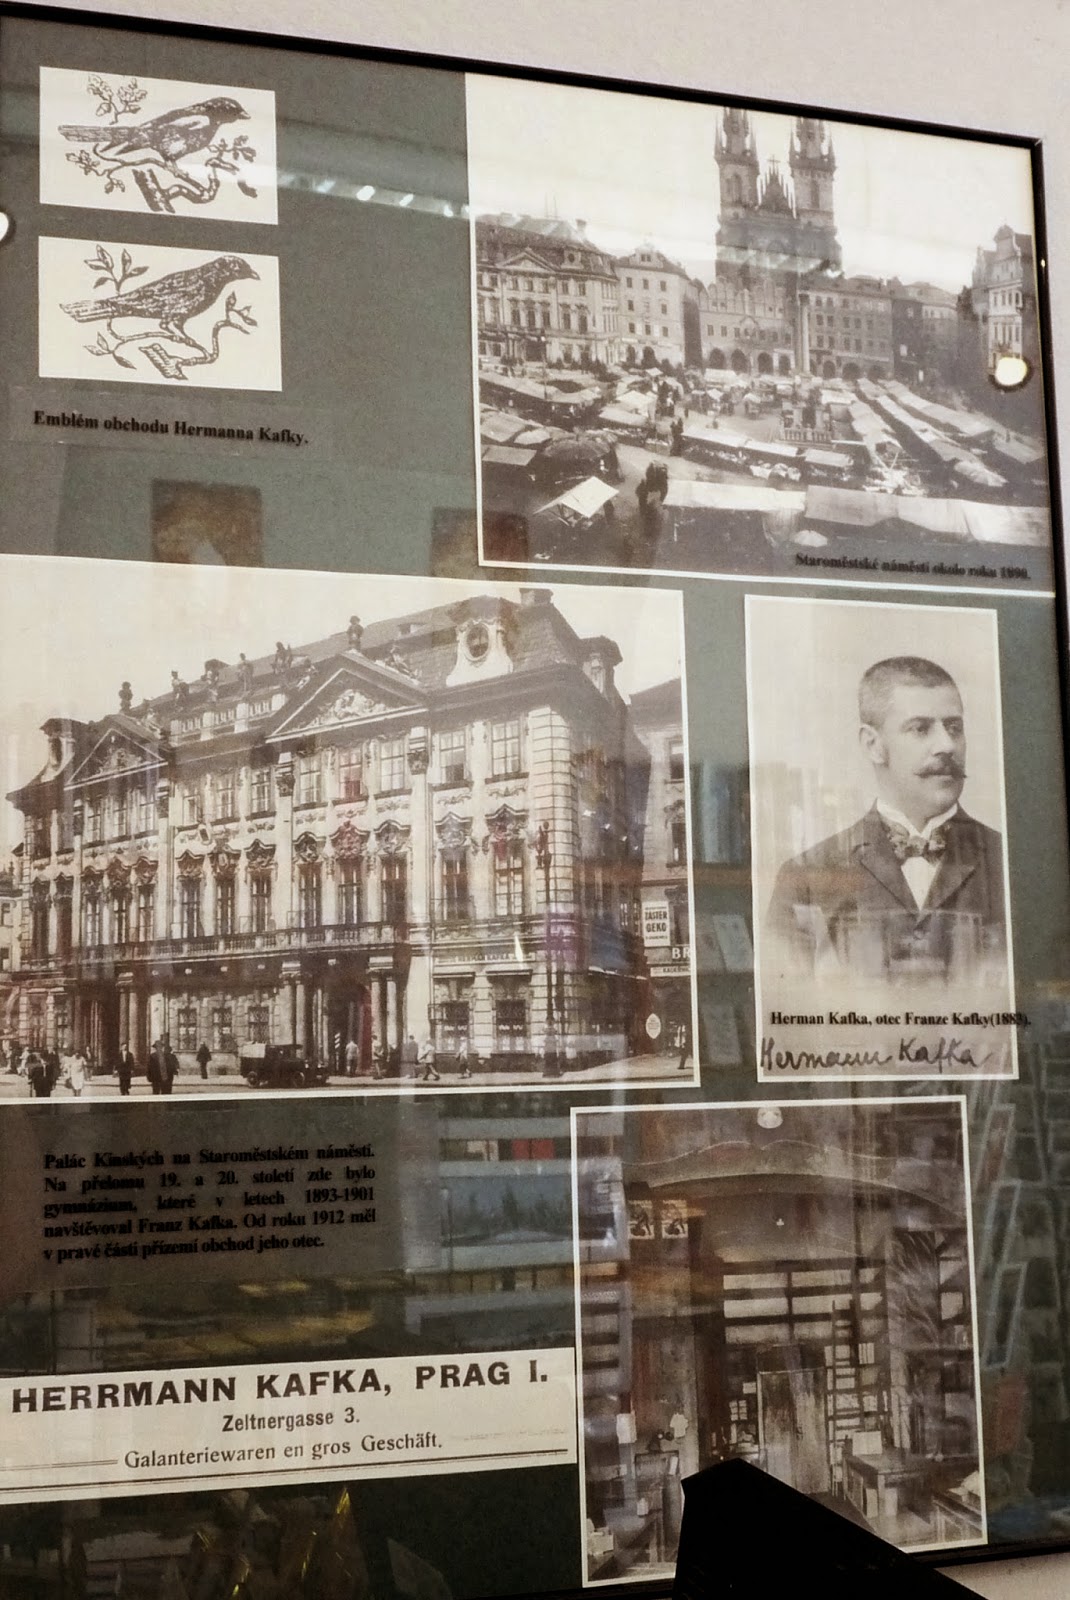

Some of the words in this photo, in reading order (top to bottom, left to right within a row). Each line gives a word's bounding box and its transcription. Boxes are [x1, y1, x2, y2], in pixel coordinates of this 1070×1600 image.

[33, 410, 99, 429] Emblém
[103, 415, 169, 434] obchodu
[174, 420, 253, 441] Hermanna
[258, 427, 309, 446] Kafky.
[770, 1011, 824, 1025] Herman
[828, 1012, 873, 1027] Kafka,
[875, 1013, 901, 1025] otec
[905, 1012, 949, 1026] Franze
[899, 1036, 985, 1073] Kafka
[44, 1153, 86, 1170] Palác
[94, 1151, 164, 1170] Kinských
[173, 1152, 191, 1165] na
[199, 1147, 309, 1164] Staroměstském
[316, 1144, 376, 1160] náměstí.
[44, 1177, 67, 1192] Na
[81, 1176, 145, 1195] přelomu
[160, 1172, 182, 1188] 19.
[194, 1174, 204, 1187] a
[217, 1170, 239, 1186] 20.
[252, 1168, 295, 1184] století
[307, 1167, 333, 1182] zde
[346, 1164, 376, 1184] bylo
[157, 1195, 195, 1211] které
[215, 1197, 225, 1208] v
[244, 1191, 285, 1207] letech
[305, 1187, 375, 1204] 1893-1901
[43, 1218, 133, 1239] navštěvoval
[138, 1216, 183, 1233] Franz
[189, 1214, 238, 1231] Kafka.
[243, 1211, 267, 1228] Od
[271, 1210, 307, 1228] roku
[312, 1209, 345, 1225] 1912
[351, 1206, 376, 1223] měl
[43, 1248, 53, 1261] v
[57, 1243, 101, 1264] pravé
[104, 1239, 138, 1259] části
[142, 1236, 199, 1260] přízemí
[201, 1233, 255, 1253] obchod
[257, 1230, 290, 1253] jeho
[292, 1230, 325, 1248] otec.
[11, 1376, 237, 1413] HERRMANN
[255, 1369, 392, 1400] KAFKA,
[415, 1360, 511, 1390] PRAG
[528, 1359, 549, 1383] I.
[222, 1408, 334, 1434] Zeltnergasse
[344, 1407, 360, 1425] 3.
[124, 1443, 276, 1470] Galanteriewaren
[283, 1444, 305, 1459] en
[311, 1437, 352, 1461] gros
[360, 1432, 443, 1453] Geschäft.
